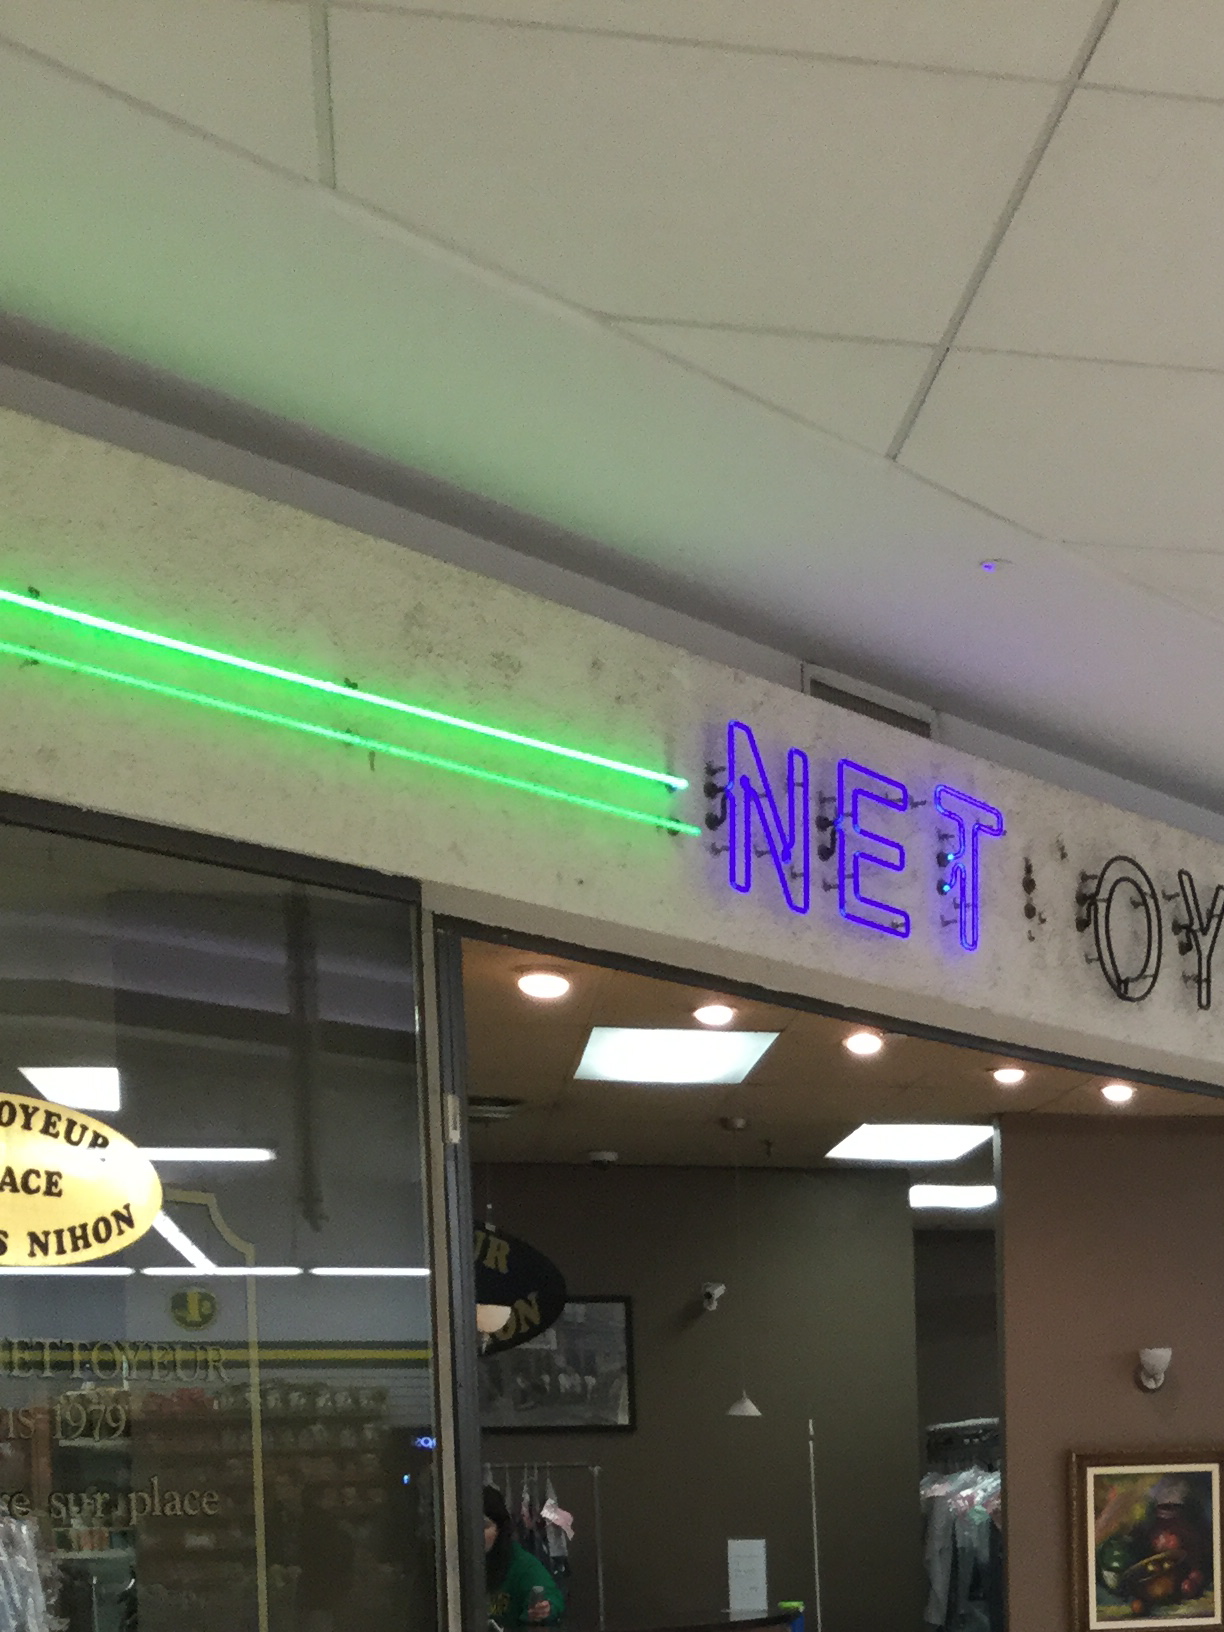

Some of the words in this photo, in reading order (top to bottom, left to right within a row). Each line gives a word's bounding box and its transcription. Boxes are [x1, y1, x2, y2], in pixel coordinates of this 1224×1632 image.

[27, 1202, 135, 1258] NIHON
[0, 1338, 231, 1383] ETTOYEUR
[52, 1401, 127, 1442] 1979
[49, 1490, 110, 1520] sur
[126, 1475, 220, 1526] place
